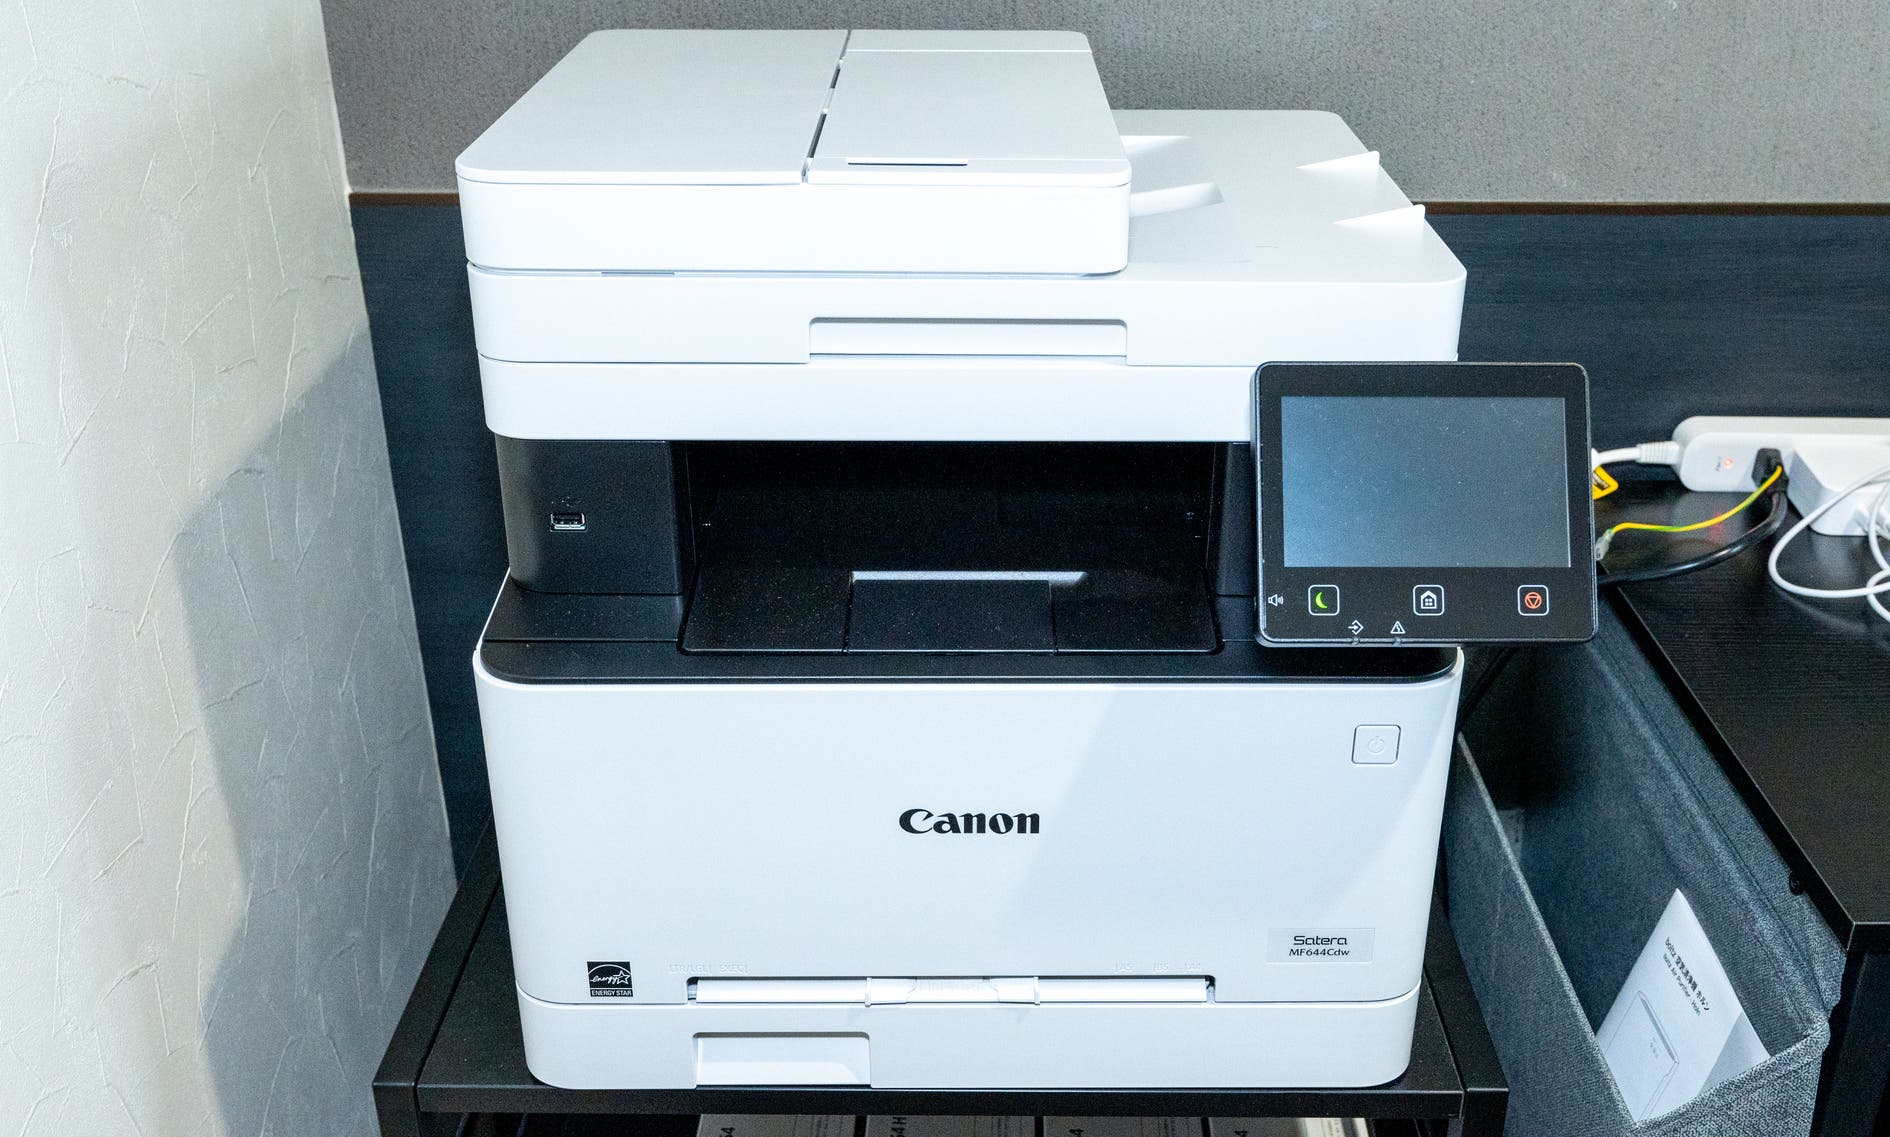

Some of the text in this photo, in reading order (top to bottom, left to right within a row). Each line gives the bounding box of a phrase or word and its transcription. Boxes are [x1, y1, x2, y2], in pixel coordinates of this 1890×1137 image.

[899, 808, 1040, 834] Canon
[1292, 935, 1348, 946] Satera
[1289, 948, 1350, 957] MF644Cdw
